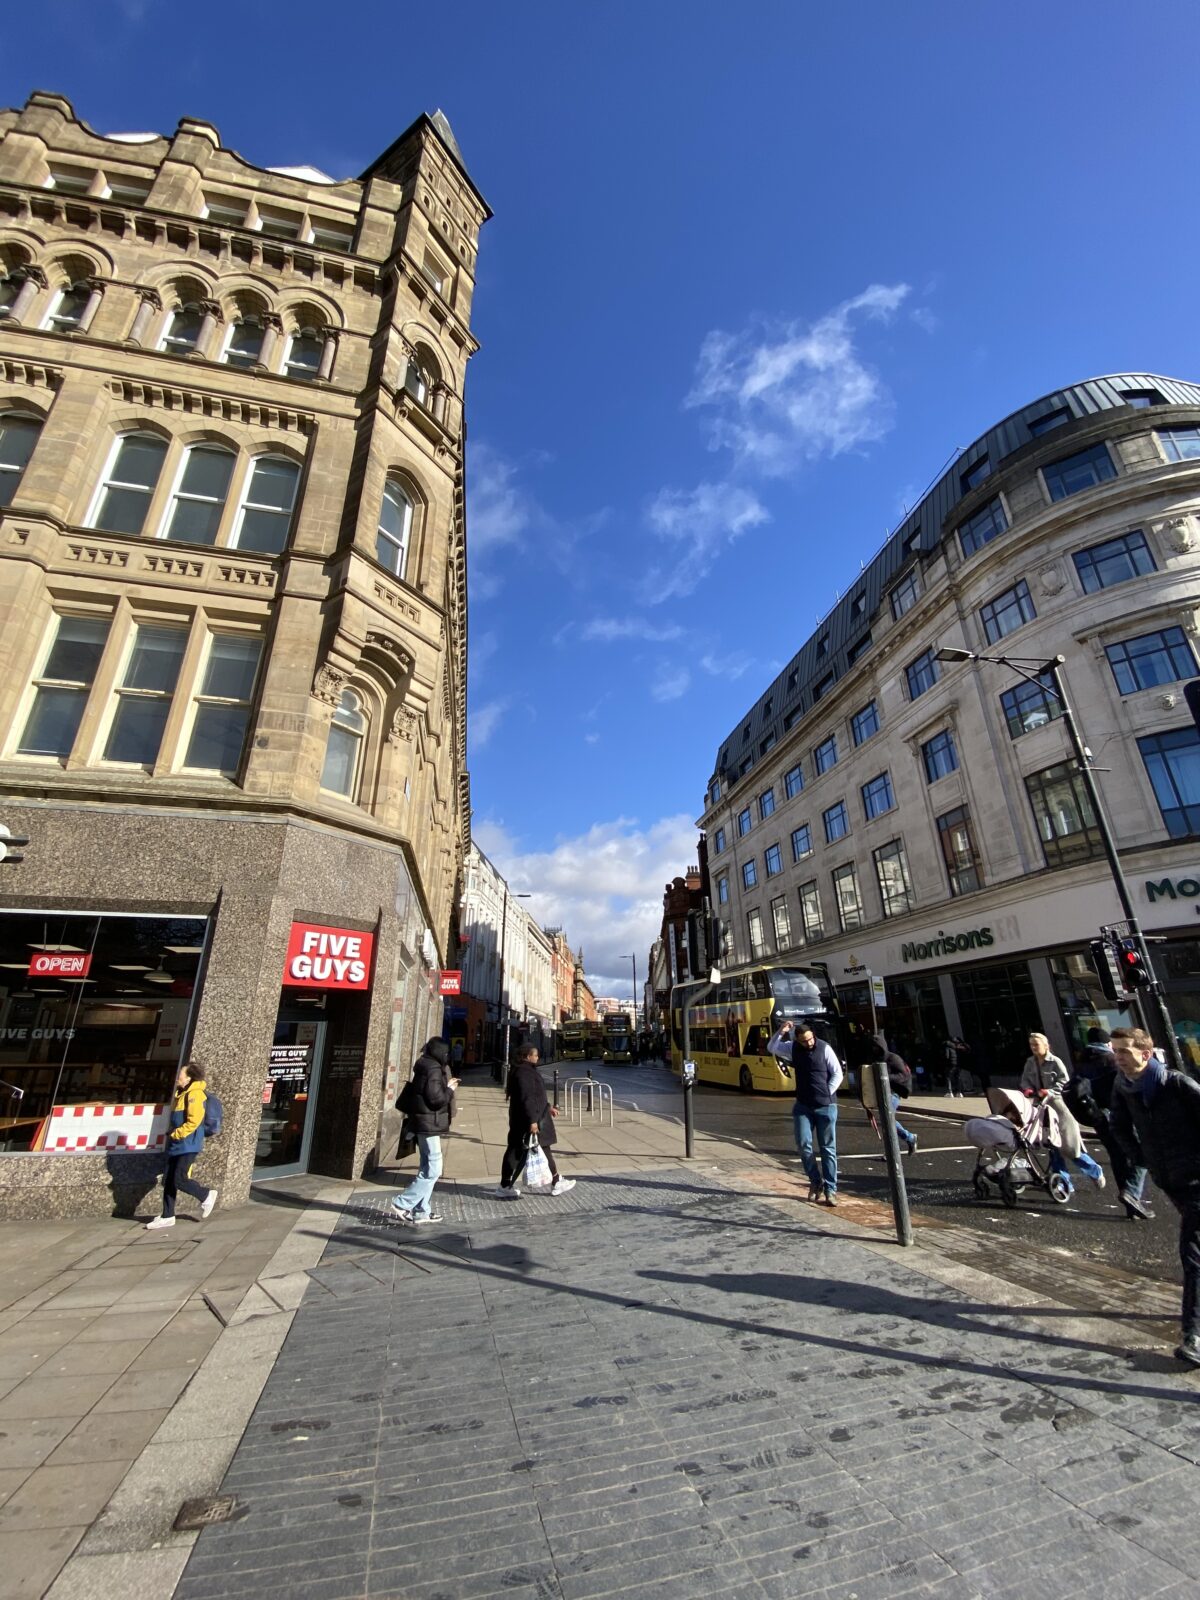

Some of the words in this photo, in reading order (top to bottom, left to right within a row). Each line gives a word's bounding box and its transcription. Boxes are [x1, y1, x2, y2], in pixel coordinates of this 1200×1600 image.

[302, 931, 362, 958] FIVE
[901, 927, 994, 963] Morrisons
[35, 957, 85, 972] OPEN
[290, 955, 366, 982] GUYS
[0, 1028, 28, 1039] IVE
[31, 1028, 76, 1040] GUYS
